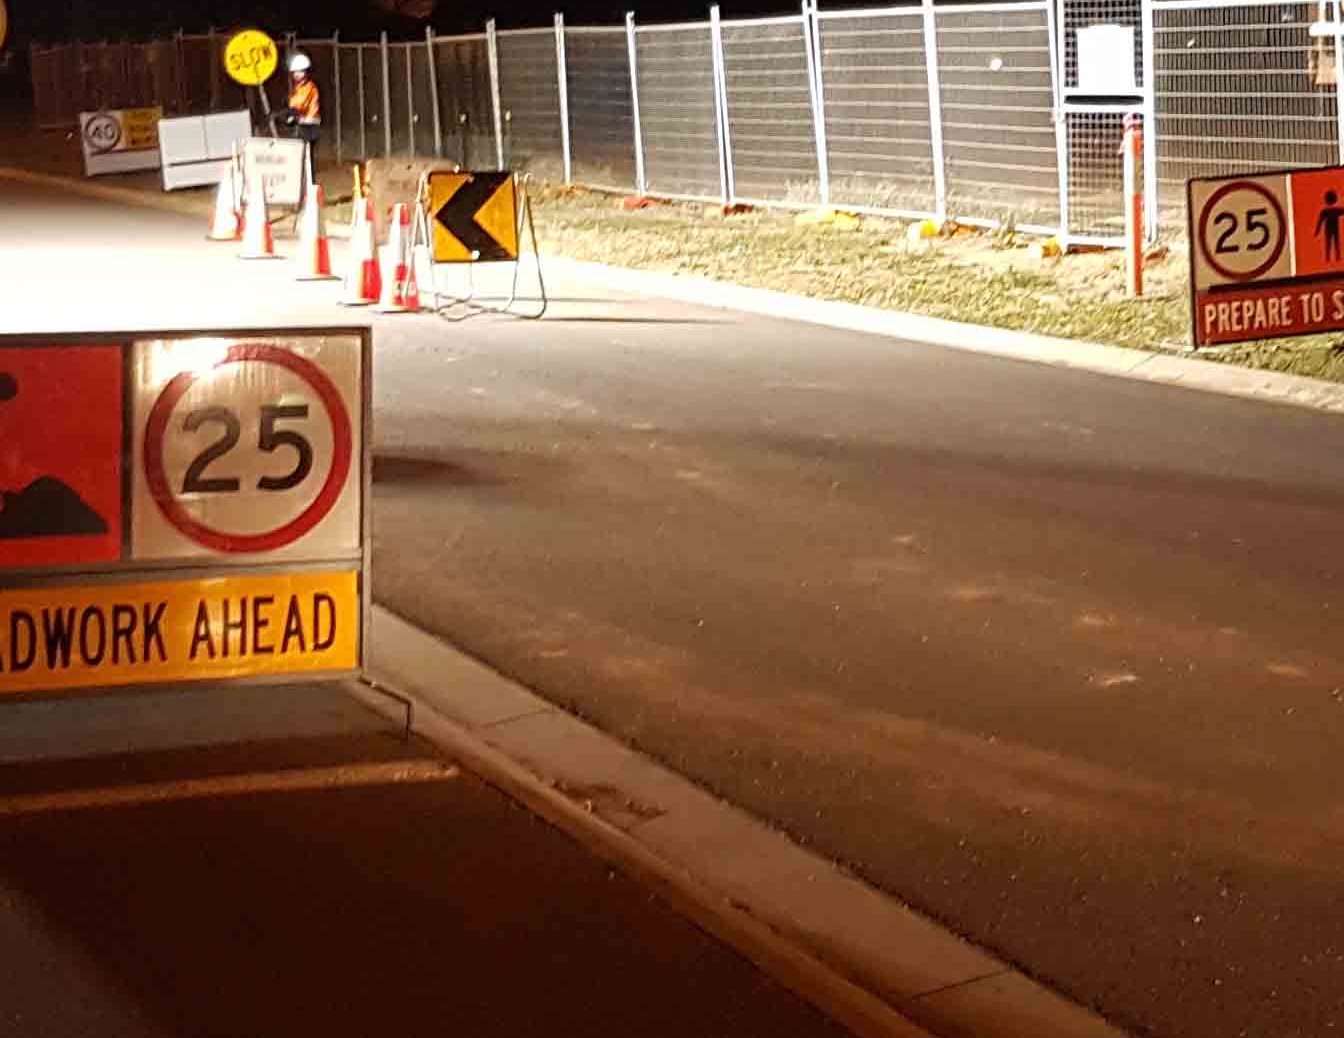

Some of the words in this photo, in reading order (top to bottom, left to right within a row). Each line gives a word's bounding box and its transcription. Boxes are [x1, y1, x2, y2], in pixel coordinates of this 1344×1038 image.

[229, 42, 273, 71] SLOW
[1213, 208, 1270, 254] 25
[1204, 295, 1293, 335] PREPARE
[1300, 292, 1325, 325] TO
[181, 403, 315, 495] 25
[189, 593, 338, 661] AHEAD
